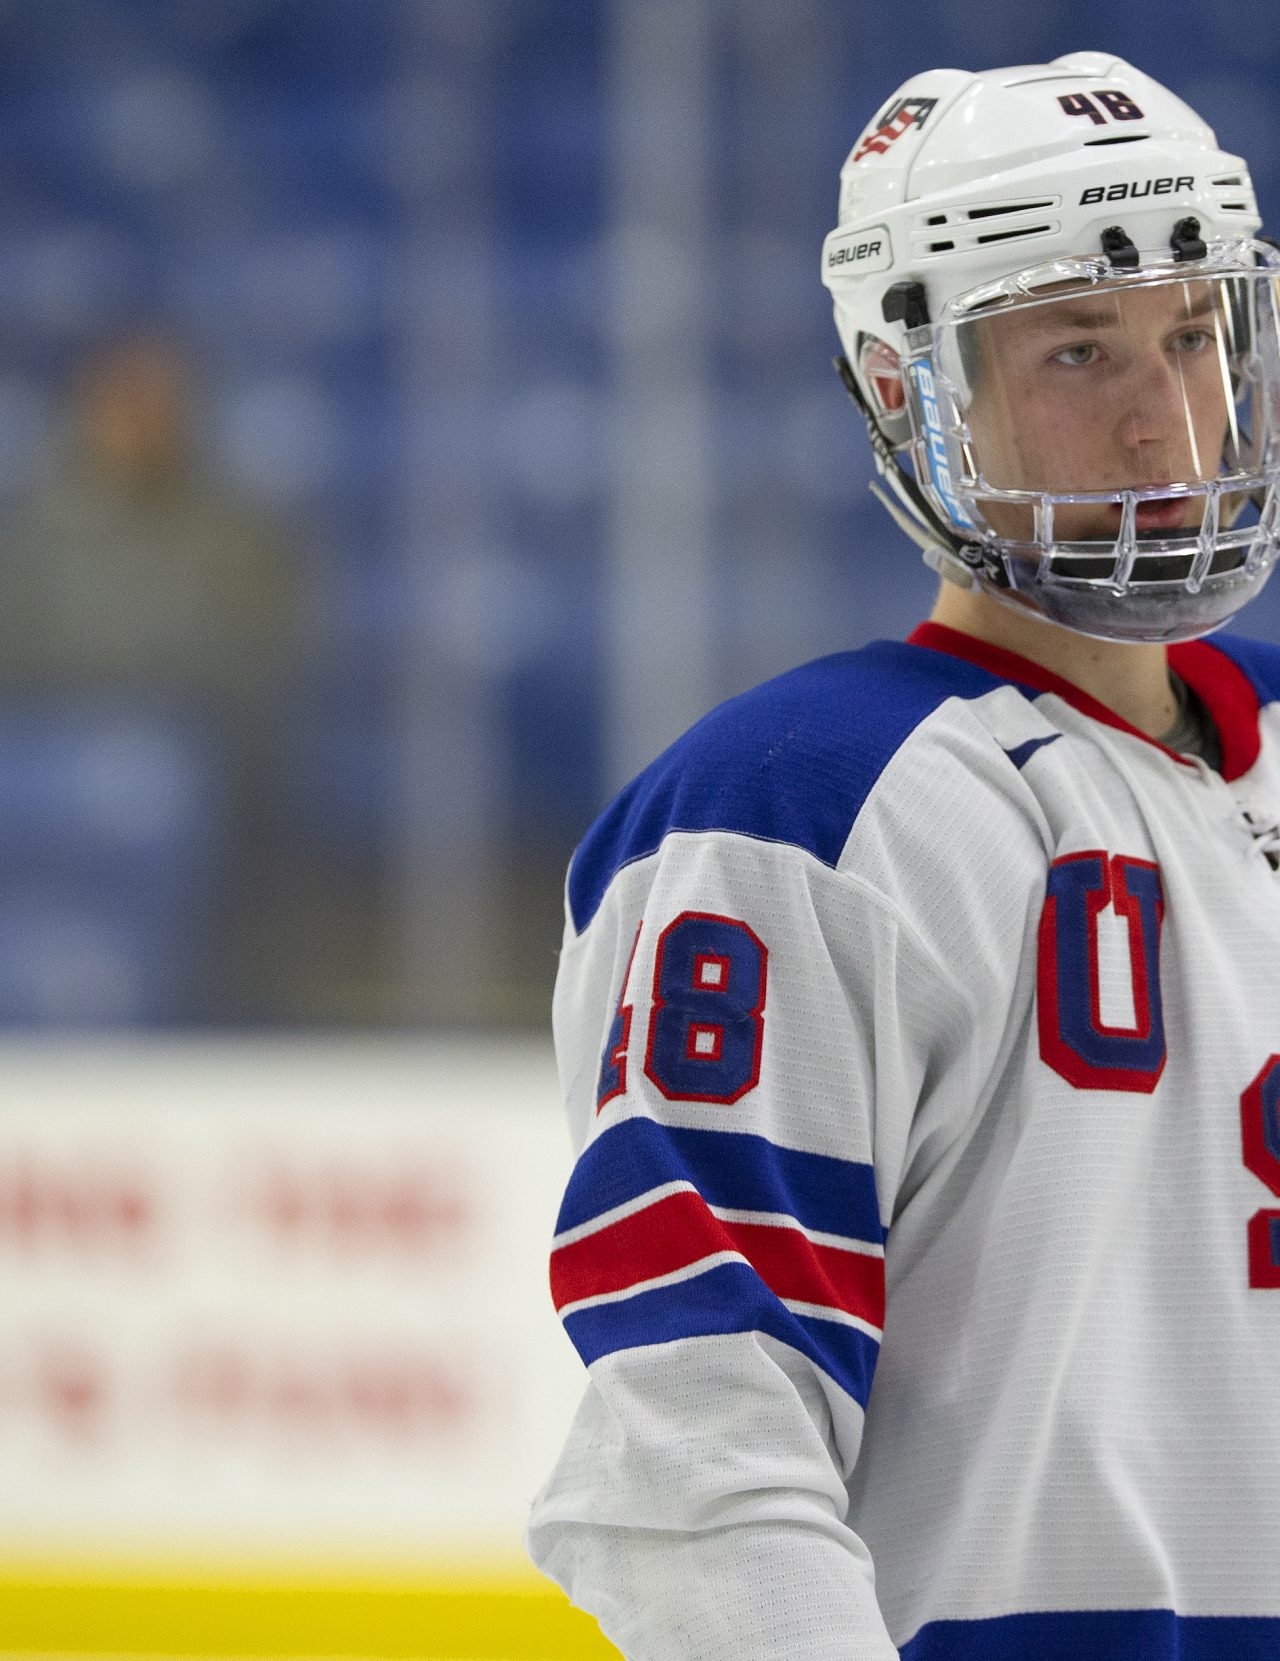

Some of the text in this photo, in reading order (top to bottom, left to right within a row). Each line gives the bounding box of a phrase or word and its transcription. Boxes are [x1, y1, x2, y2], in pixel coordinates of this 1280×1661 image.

[1056, 89, 1145, 126] 48
[1079, 176, 1195, 206] BAUER
[828, 240, 882, 268] BAUER
